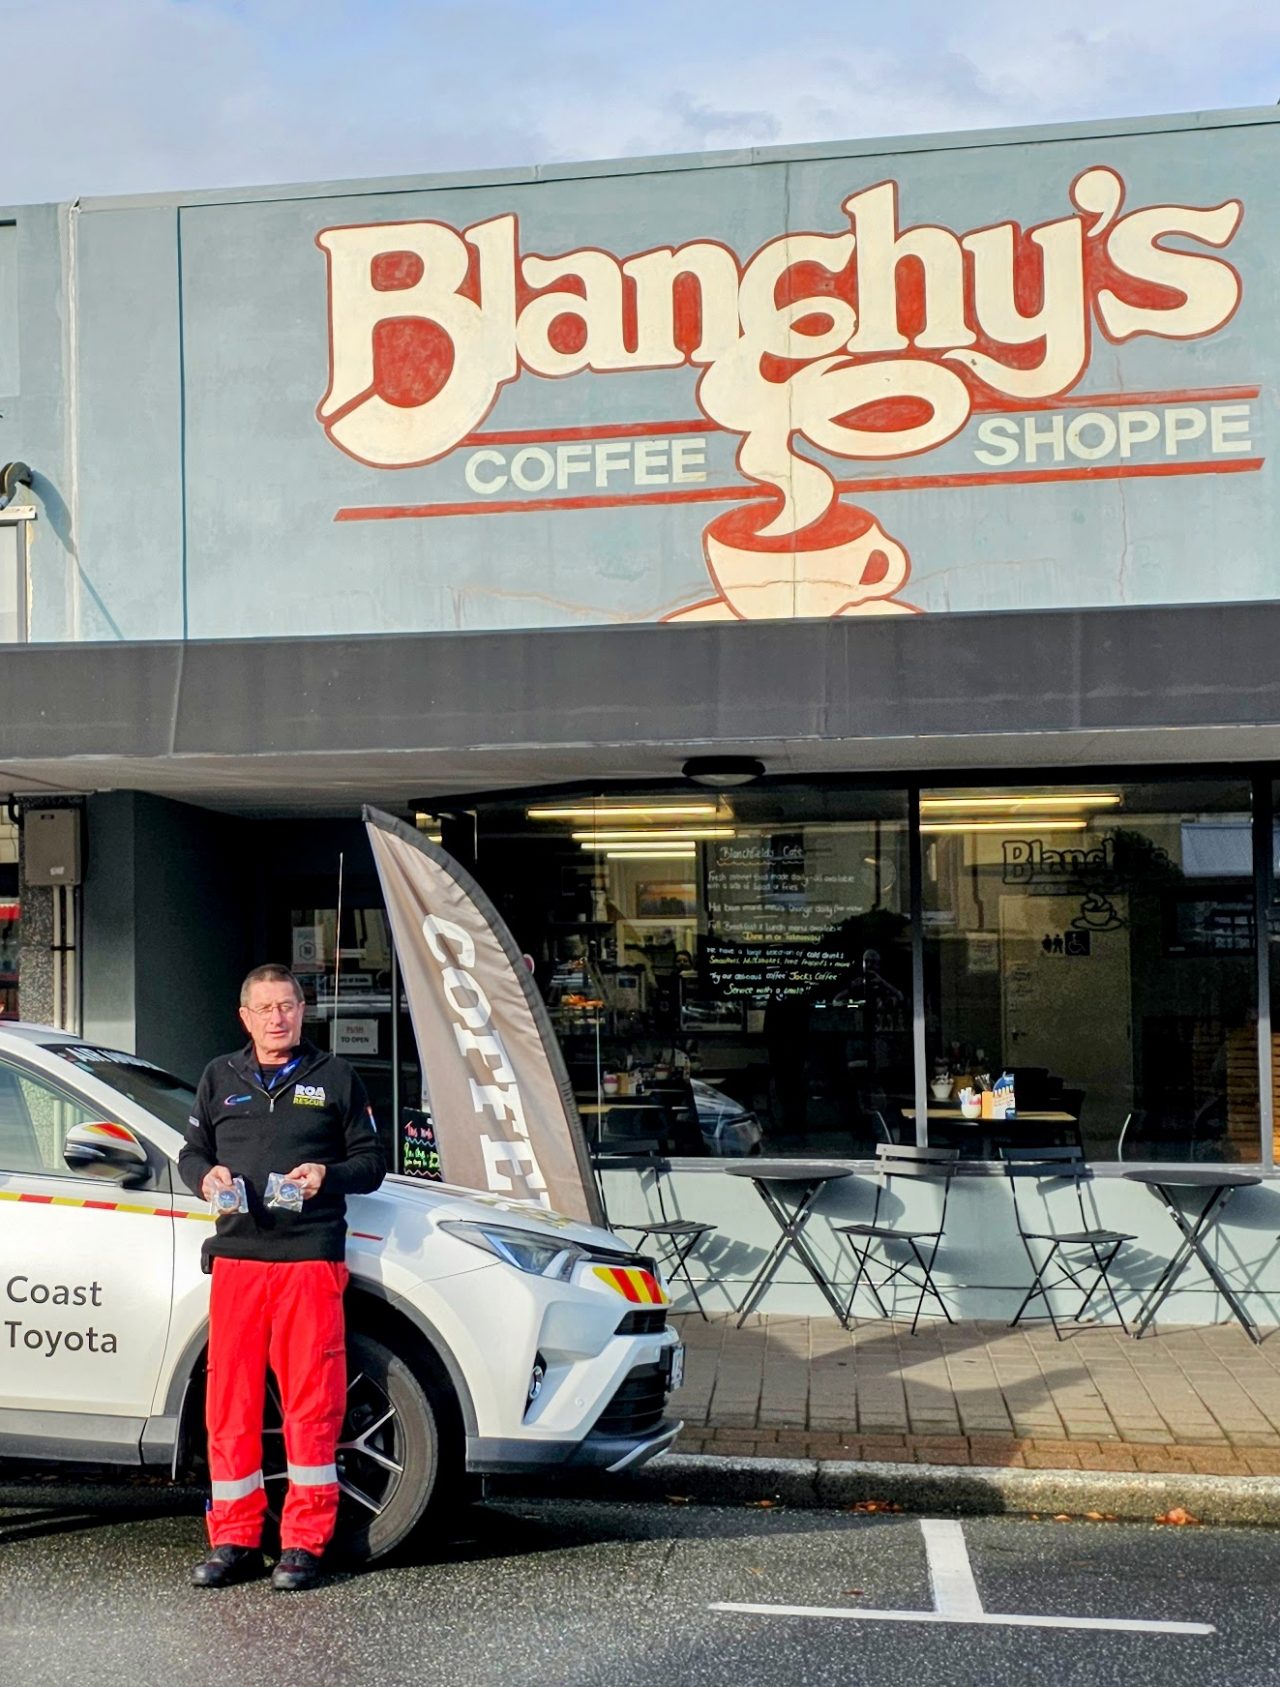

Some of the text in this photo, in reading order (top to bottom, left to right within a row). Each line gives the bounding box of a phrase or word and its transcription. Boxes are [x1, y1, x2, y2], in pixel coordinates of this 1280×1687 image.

[463, 402, 1253, 496] COFFEE SHOPPE
[422, 914, 551, 1211] COFFE
[295, 1083, 326, 1096] ROA
[6, 1275, 103, 1307] Coast
[4, 1320, 118, 1358] Toyota
